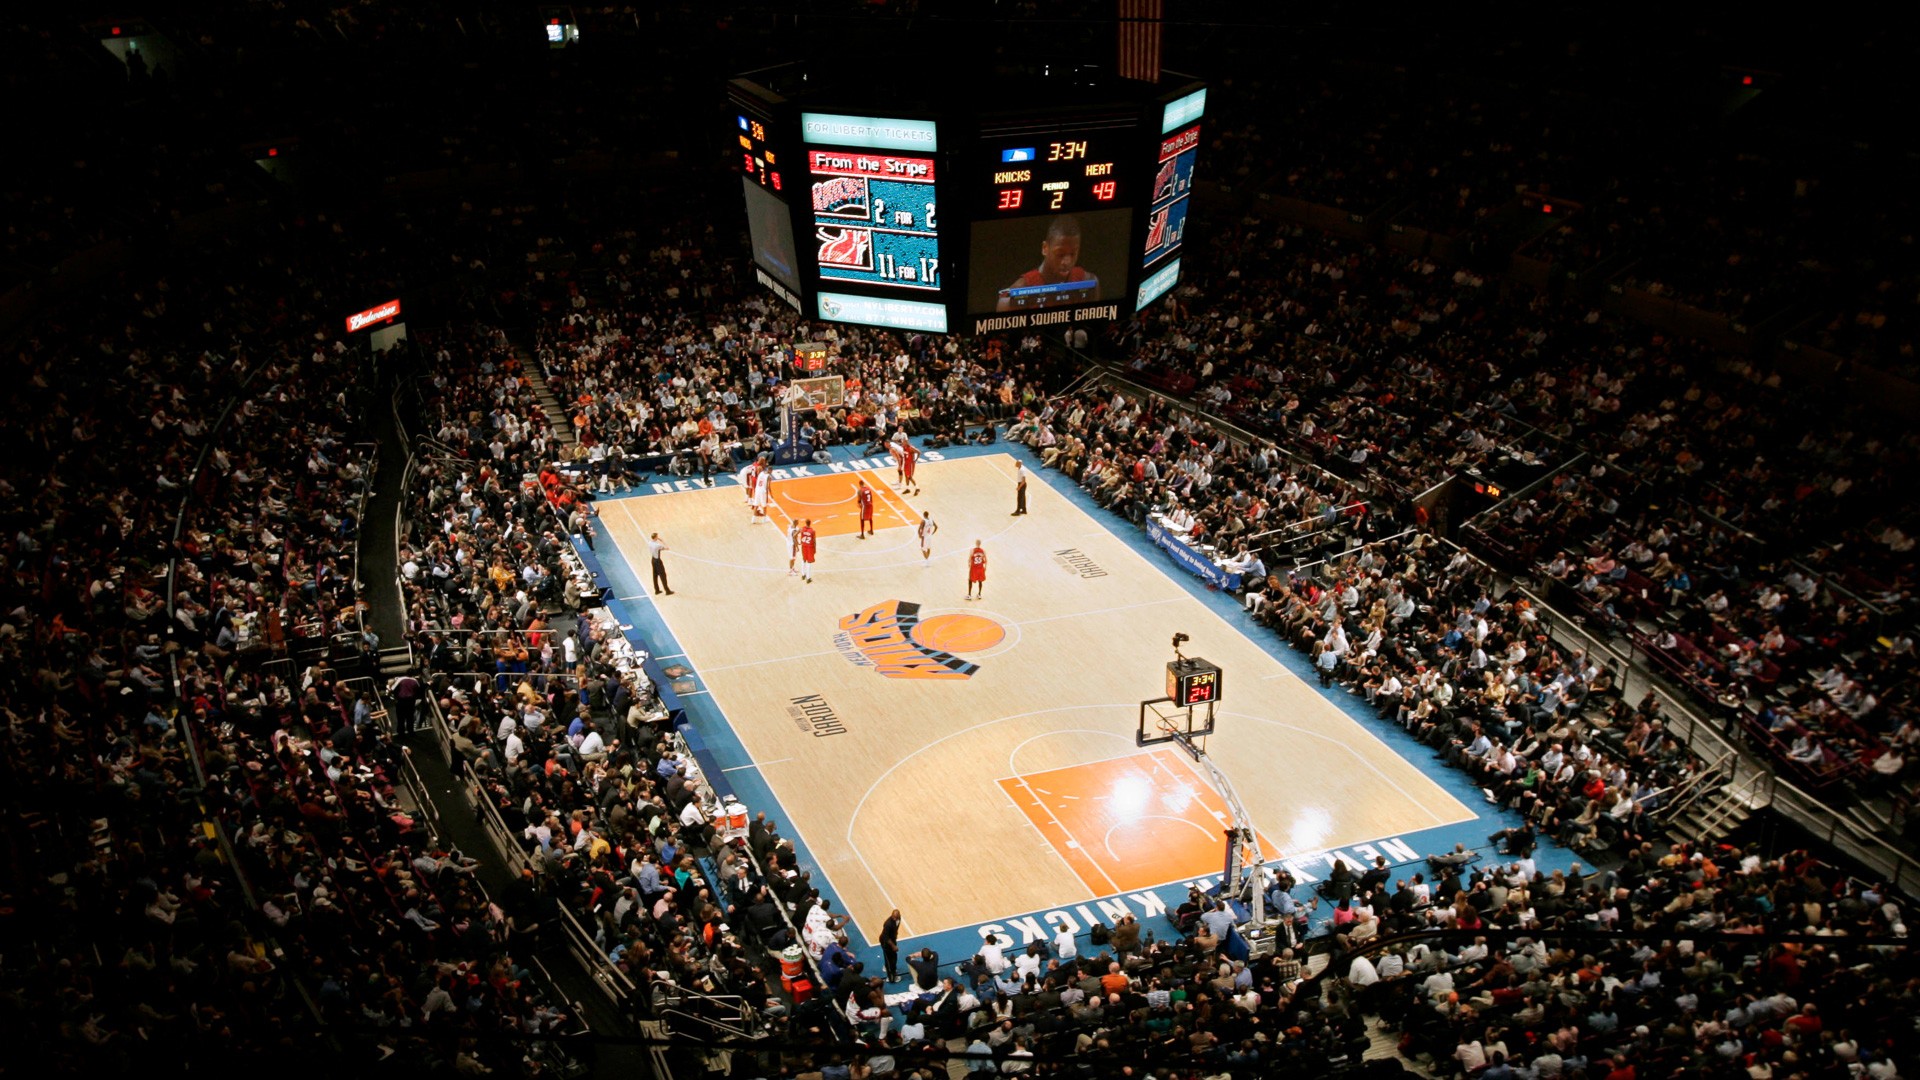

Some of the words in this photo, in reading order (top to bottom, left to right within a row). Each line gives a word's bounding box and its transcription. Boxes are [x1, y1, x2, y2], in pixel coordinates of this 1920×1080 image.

[806, 122, 829, 133] FOR
[833, 125, 880, 136] LIBERTY
[885, 128, 933, 141] TICKETS
[1048, 141, 1087, 161] 3:34
[815, 153, 852, 169] From
[857, 157, 880, 171] the
[885, 158, 927, 177] Stripe
[1085, 163, 1113, 176] HEAT
[994, 170, 1031, 184] KNICKS
[1042, 181, 1069, 191] PERIOD
[998, 190, 1022, 209] 33
[1050, 191, 1063, 209] 2
[1092, 182, 1116, 200] 49
[874, 198, 885, 224] 2
[894, 210, 913, 225] FOR
[925, 202, 937, 229] 2
[878, 253, 896, 279] 11
[898, 265, 917, 280] FOR
[919, 257, 939, 283] 17
[350, 305, 397, 331] Budweiser
[863, 301, 944, 316] NYLIBERTY.COM
[975, 314, 1027, 336] MADISON
[1030, 310, 1070, 326] SQUARE
[1074, 304, 1118, 321] GARDEN
[808, 359, 823, 370] 24
[652, 477, 715, 494] NEW
[828, 451, 945, 474] KNICS
[1054, 548, 1108, 579] GARDEN
[1191, 674, 1214, 687] 3:34
[1189, 686, 1211, 702] 24
[790, 694, 847, 737] GARDEN
